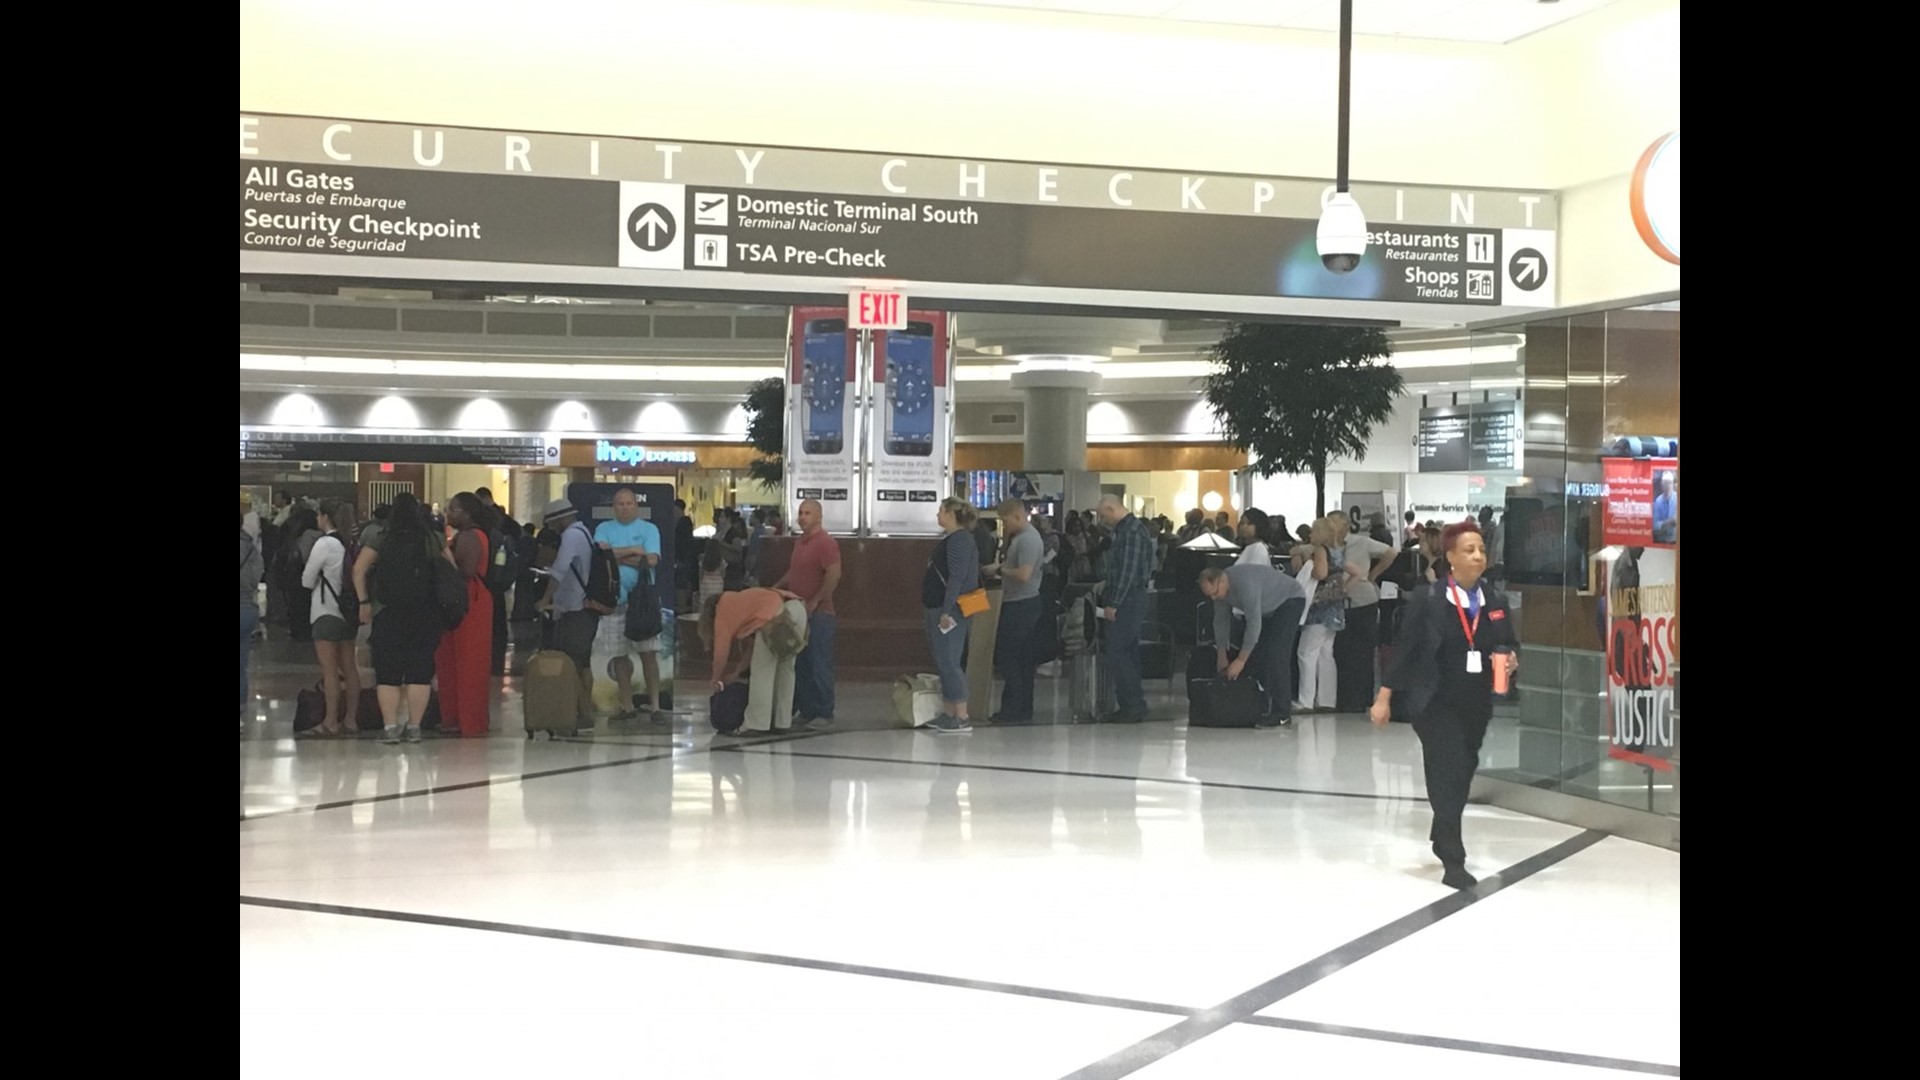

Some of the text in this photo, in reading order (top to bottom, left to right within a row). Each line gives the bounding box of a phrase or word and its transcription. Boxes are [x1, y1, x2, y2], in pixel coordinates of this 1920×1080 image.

[245, 166, 354, 191] All Gates
[245, 188, 407, 211] Puertas de Embarque
[737, 194, 979, 225] Domestic Terminal South
[244, 208, 482, 241] Security Checkpoint
[738, 215, 882, 235] Terminal Nacional Sur
[244, 232, 407, 253] Control de Seguridad
[1366, 231, 1460, 249] estaurants
[735, 243, 886, 267] TSA Pre-Check
[1385, 248, 1459, 262] Restaurantes
[1405, 266, 1459, 288] Shops
[1416, 285, 1459, 299] Tiendas
[860, 293, 900, 325] EXIT
[597, 440, 697, 466] ihop EXPRESS
[1409, 503, 1440, 512] Customer
[1441, 503, 1464, 512] Service
[1610, 618, 1675, 687] CROSS
